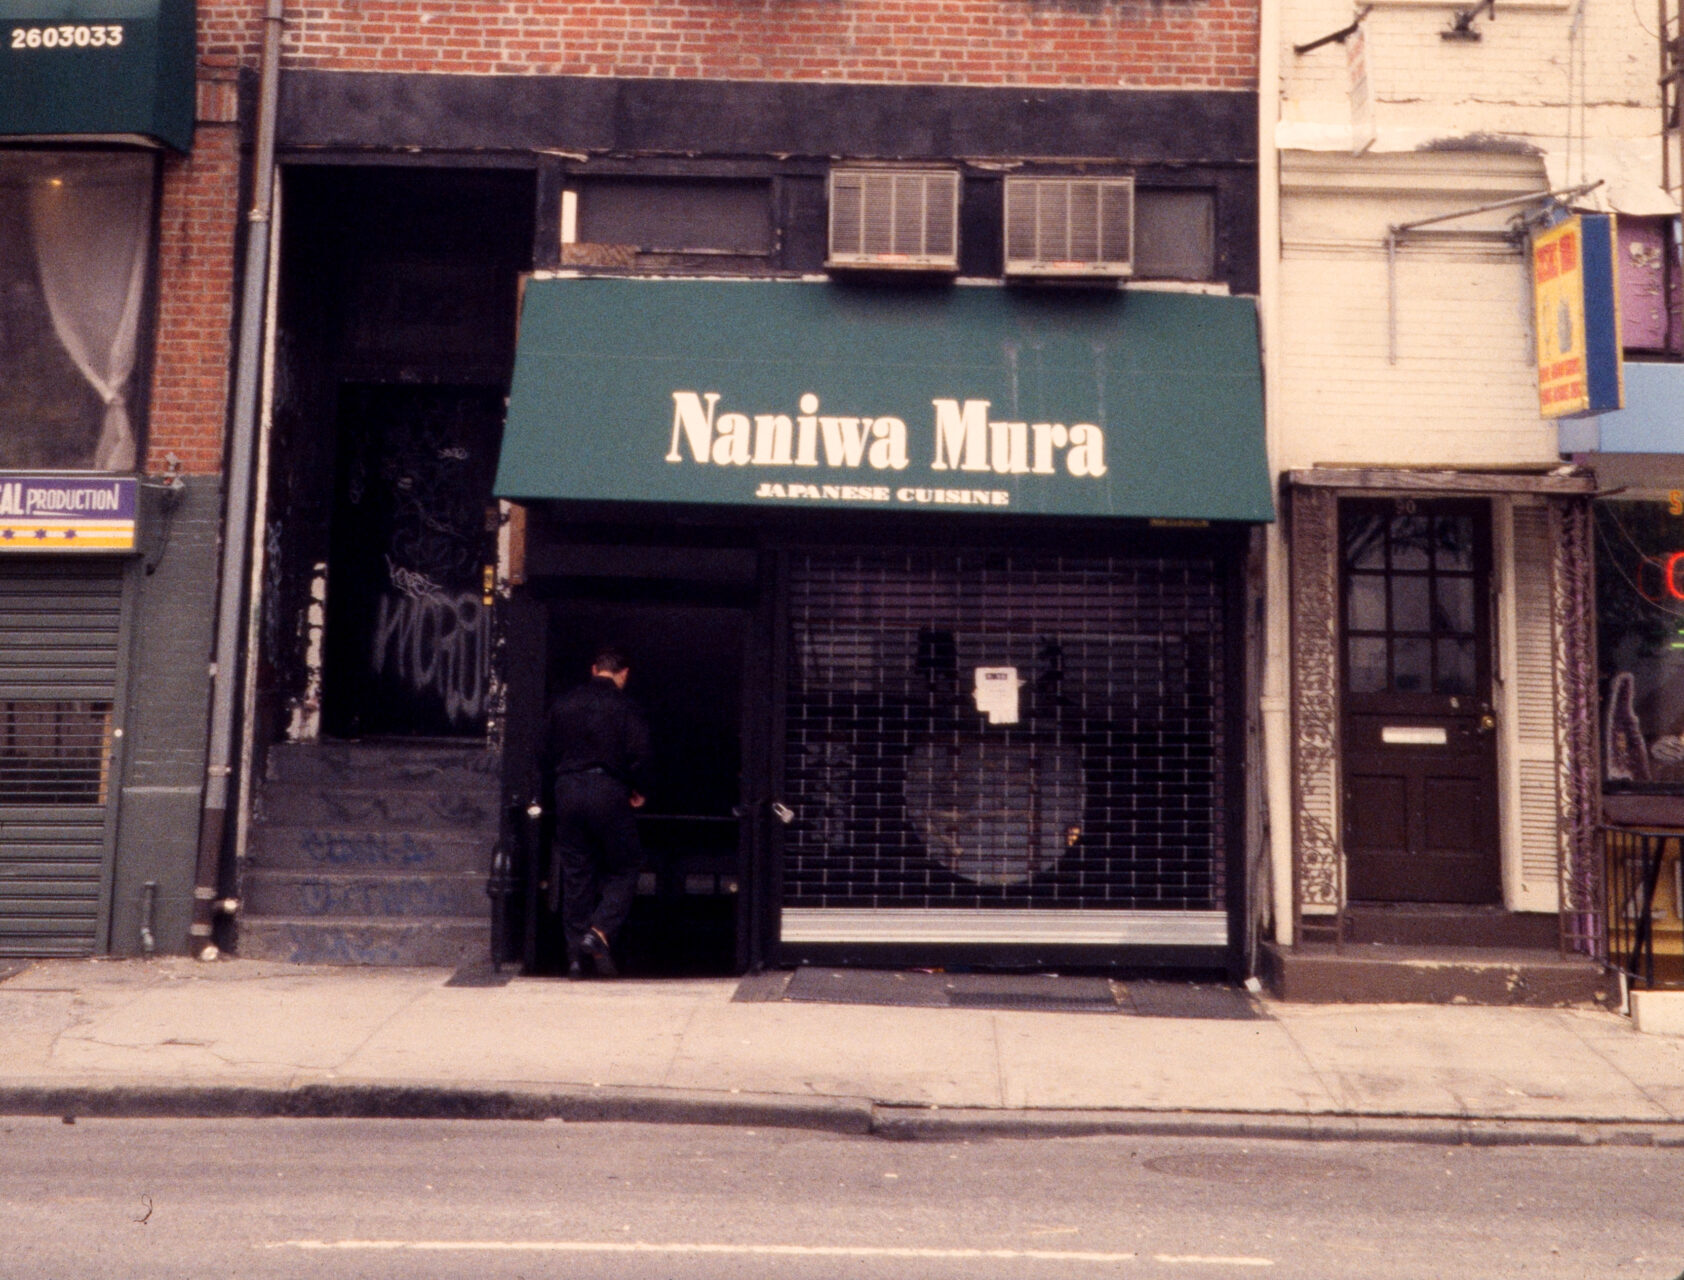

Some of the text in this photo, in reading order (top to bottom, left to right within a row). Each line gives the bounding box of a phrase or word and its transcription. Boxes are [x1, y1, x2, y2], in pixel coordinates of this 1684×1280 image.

[11, 25, 123, 48] 2603033
[665, 391, 1107, 478] Naniwa Mura
[0, 482, 119, 515] AL PRODUCTION
[755, 483, 1009, 506] JAPANESE CUISINE
